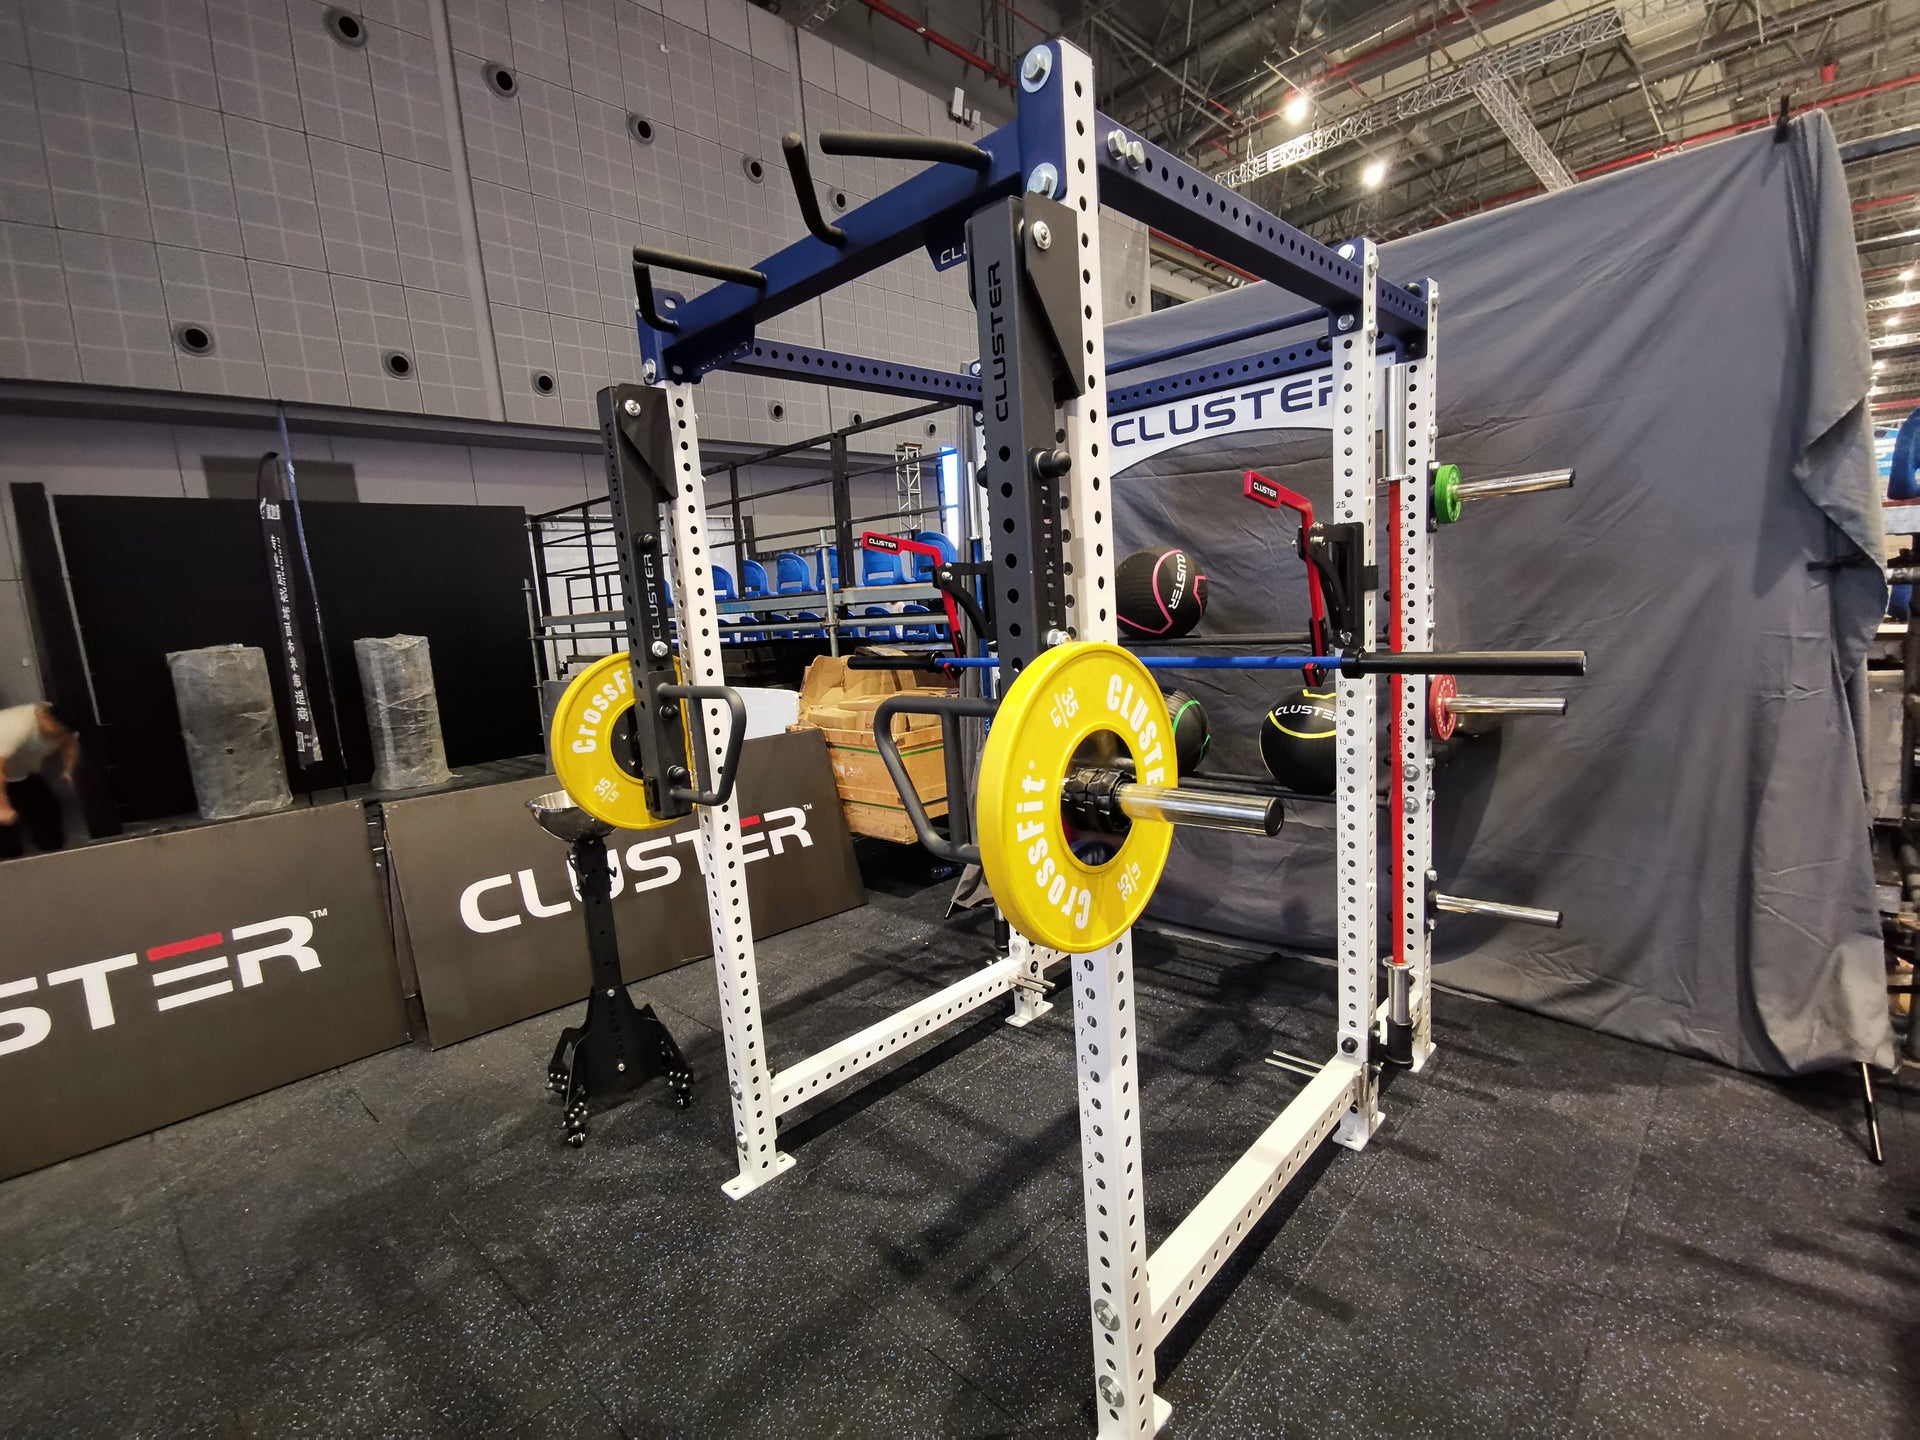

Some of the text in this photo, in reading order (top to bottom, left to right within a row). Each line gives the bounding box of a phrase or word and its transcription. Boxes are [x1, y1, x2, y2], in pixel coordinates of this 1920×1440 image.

[987, 260, 1009, 422] CLUSTER
[1253, 481, 1277, 498] CLUSTER
[869, 538, 897, 549] CLUSTER
[1168, 553, 1187, 610] CLUSTER
[643, 553, 662, 641] CLUSTER
[572, 667, 635, 754] CrossFi
[1061, 686, 1079, 718] 35
[1050, 707, 1062, 728] LB
[1107, 674, 1165, 786] CLUSTE
[593, 777, 611, 797] 35
[608, 790, 619, 802] LB
[1016, 774, 1092, 930] CrossFit
[1131, 862, 1141, 881] LB
[1117, 873, 1132, 901] 35
